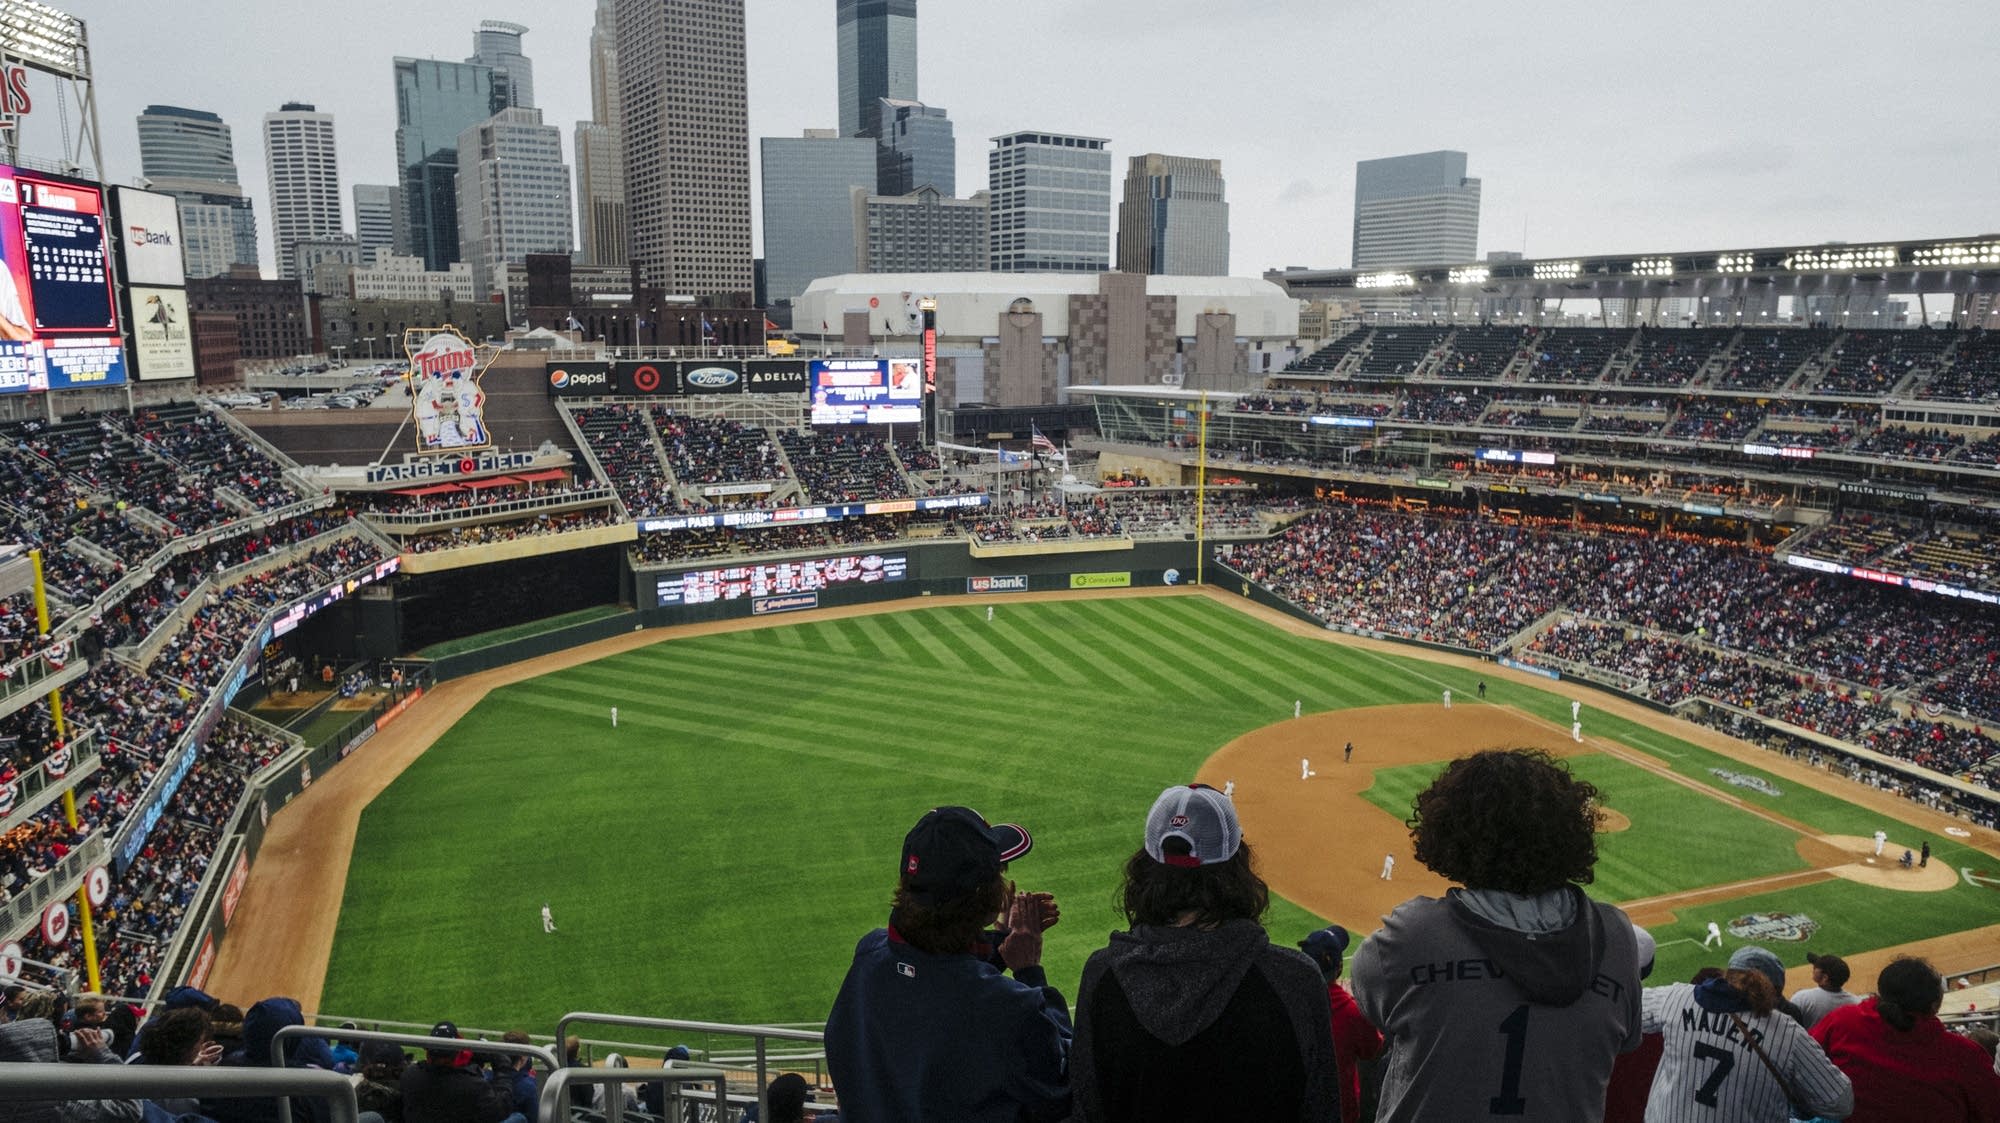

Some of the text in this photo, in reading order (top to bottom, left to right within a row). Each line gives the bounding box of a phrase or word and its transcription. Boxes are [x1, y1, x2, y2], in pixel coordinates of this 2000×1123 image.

[414, 348, 475, 380] Twins
[570, 372, 606, 386] pepsi
[698, 370, 729, 384] Ford
[764, 372, 803, 381] DELTA
[371, 454, 535, 482] TARGET FIELD
[1848, 485, 1873, 494] DELTA
[1905, 493, 1924, 501] CLUB
[959, 496, 981, 507] PASS
[688, 516, 715, 528] PASS
[972, 576, 1025, 591] usbank
[1088, 574, 1125, 585] CenturyLink
[95, 878, 103, 894] 3
[1411, 958, 1625, 1004] CHEVET
[1682, 1008, 1764, 1053] MAUER
[1489, 1005, 1530, 1115] 1
[1693, 1040, 1735, 1109] 7
